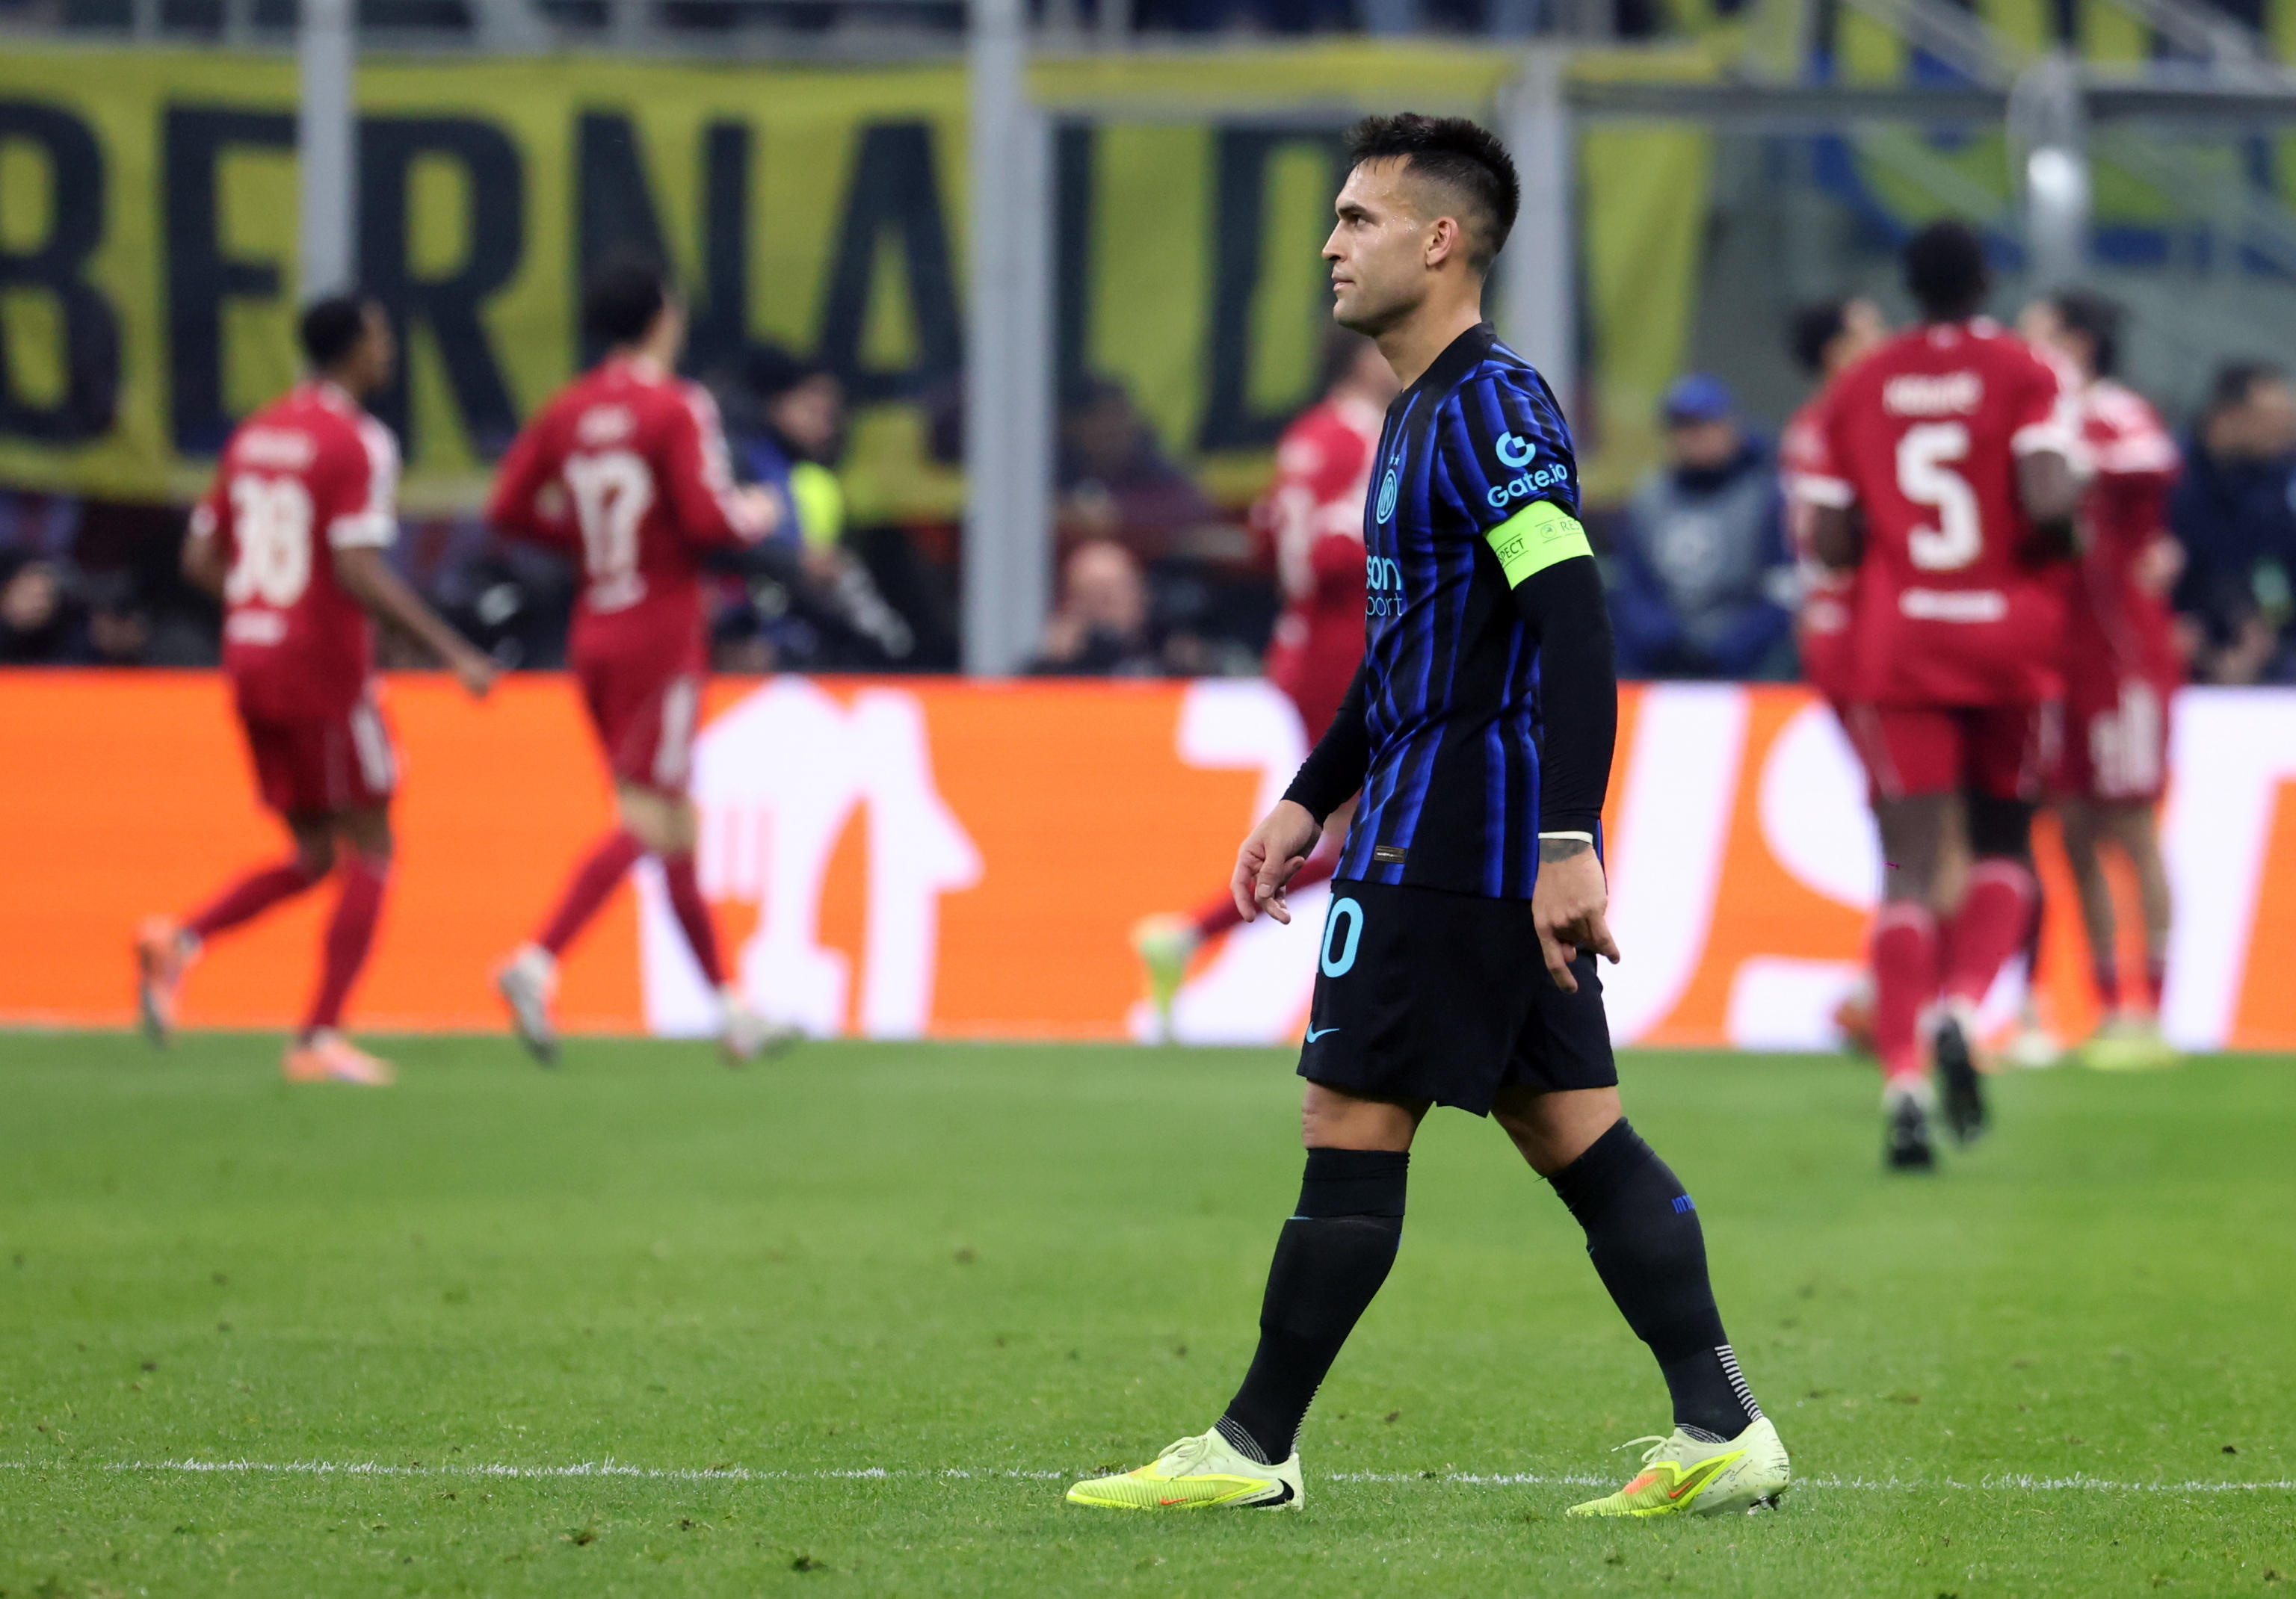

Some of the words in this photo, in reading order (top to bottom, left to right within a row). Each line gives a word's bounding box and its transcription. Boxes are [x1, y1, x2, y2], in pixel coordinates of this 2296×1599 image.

[566, 451, 652, 575] 17
[1487, 463, 1568, 508] Gate.io
[1896, 421, 1981, 572] 5
[1317, 892, 1363, 978] 0
